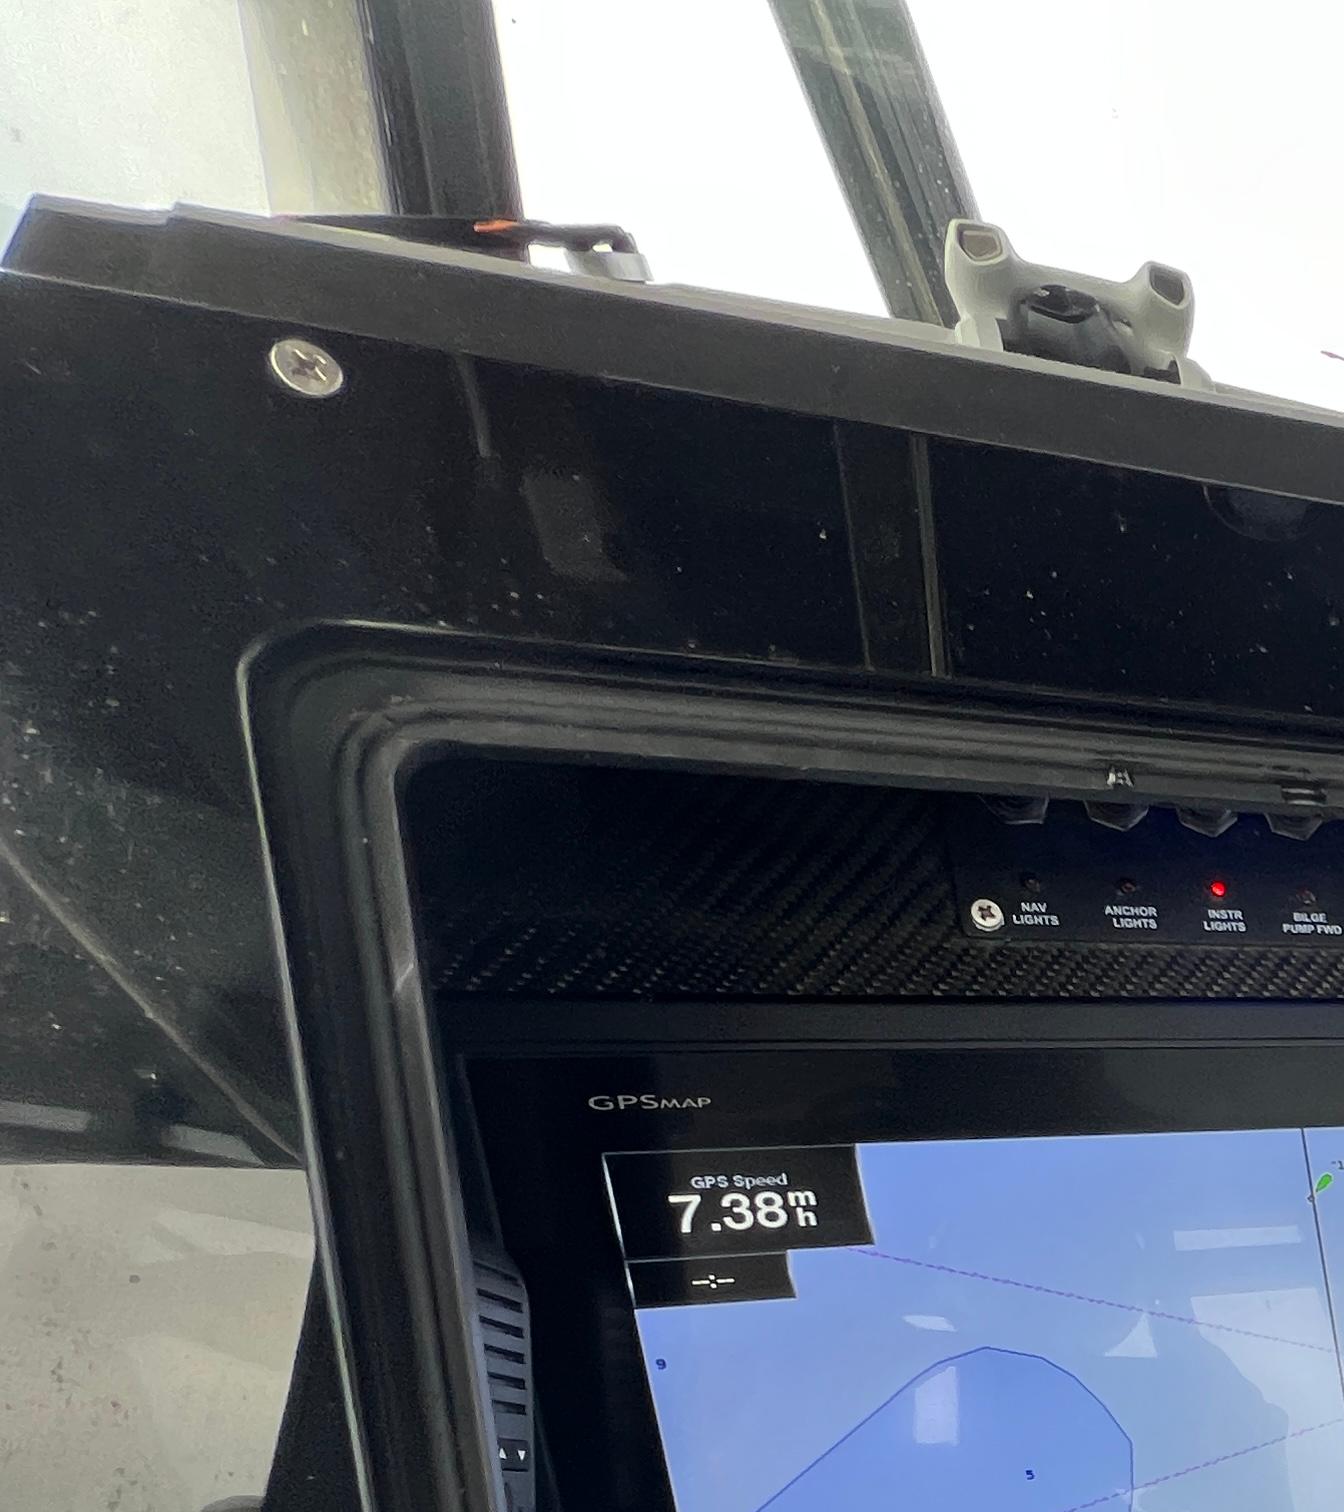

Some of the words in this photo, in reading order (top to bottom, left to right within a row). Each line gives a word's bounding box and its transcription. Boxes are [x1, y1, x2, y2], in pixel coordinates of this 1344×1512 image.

[1020, 902, 1047, 913] NAV
[1104, 905, 1158, 918] ANCHOR
[1012, 914, 1060, 926] LIGHTS
[1208, 909, 1244, 921] INSTR
[1293, 912, 1327, 924] BILGE
[1112, 917, 1157, 929] LIGHTS
[1203, 920, 1247, 932] LIGHTS
[1282, 923, 1315, 935] PUMP
[1316, 924, 1343, 935] FWD
[690, 1175, 729, 1189] GPS
[733, 1173, 788, 1190] Speed
[667, 1191, 788, 1234] 7.38
[656, 1358, 667, 1370] 9
[1025, 1470, 1035, 1480] 5
